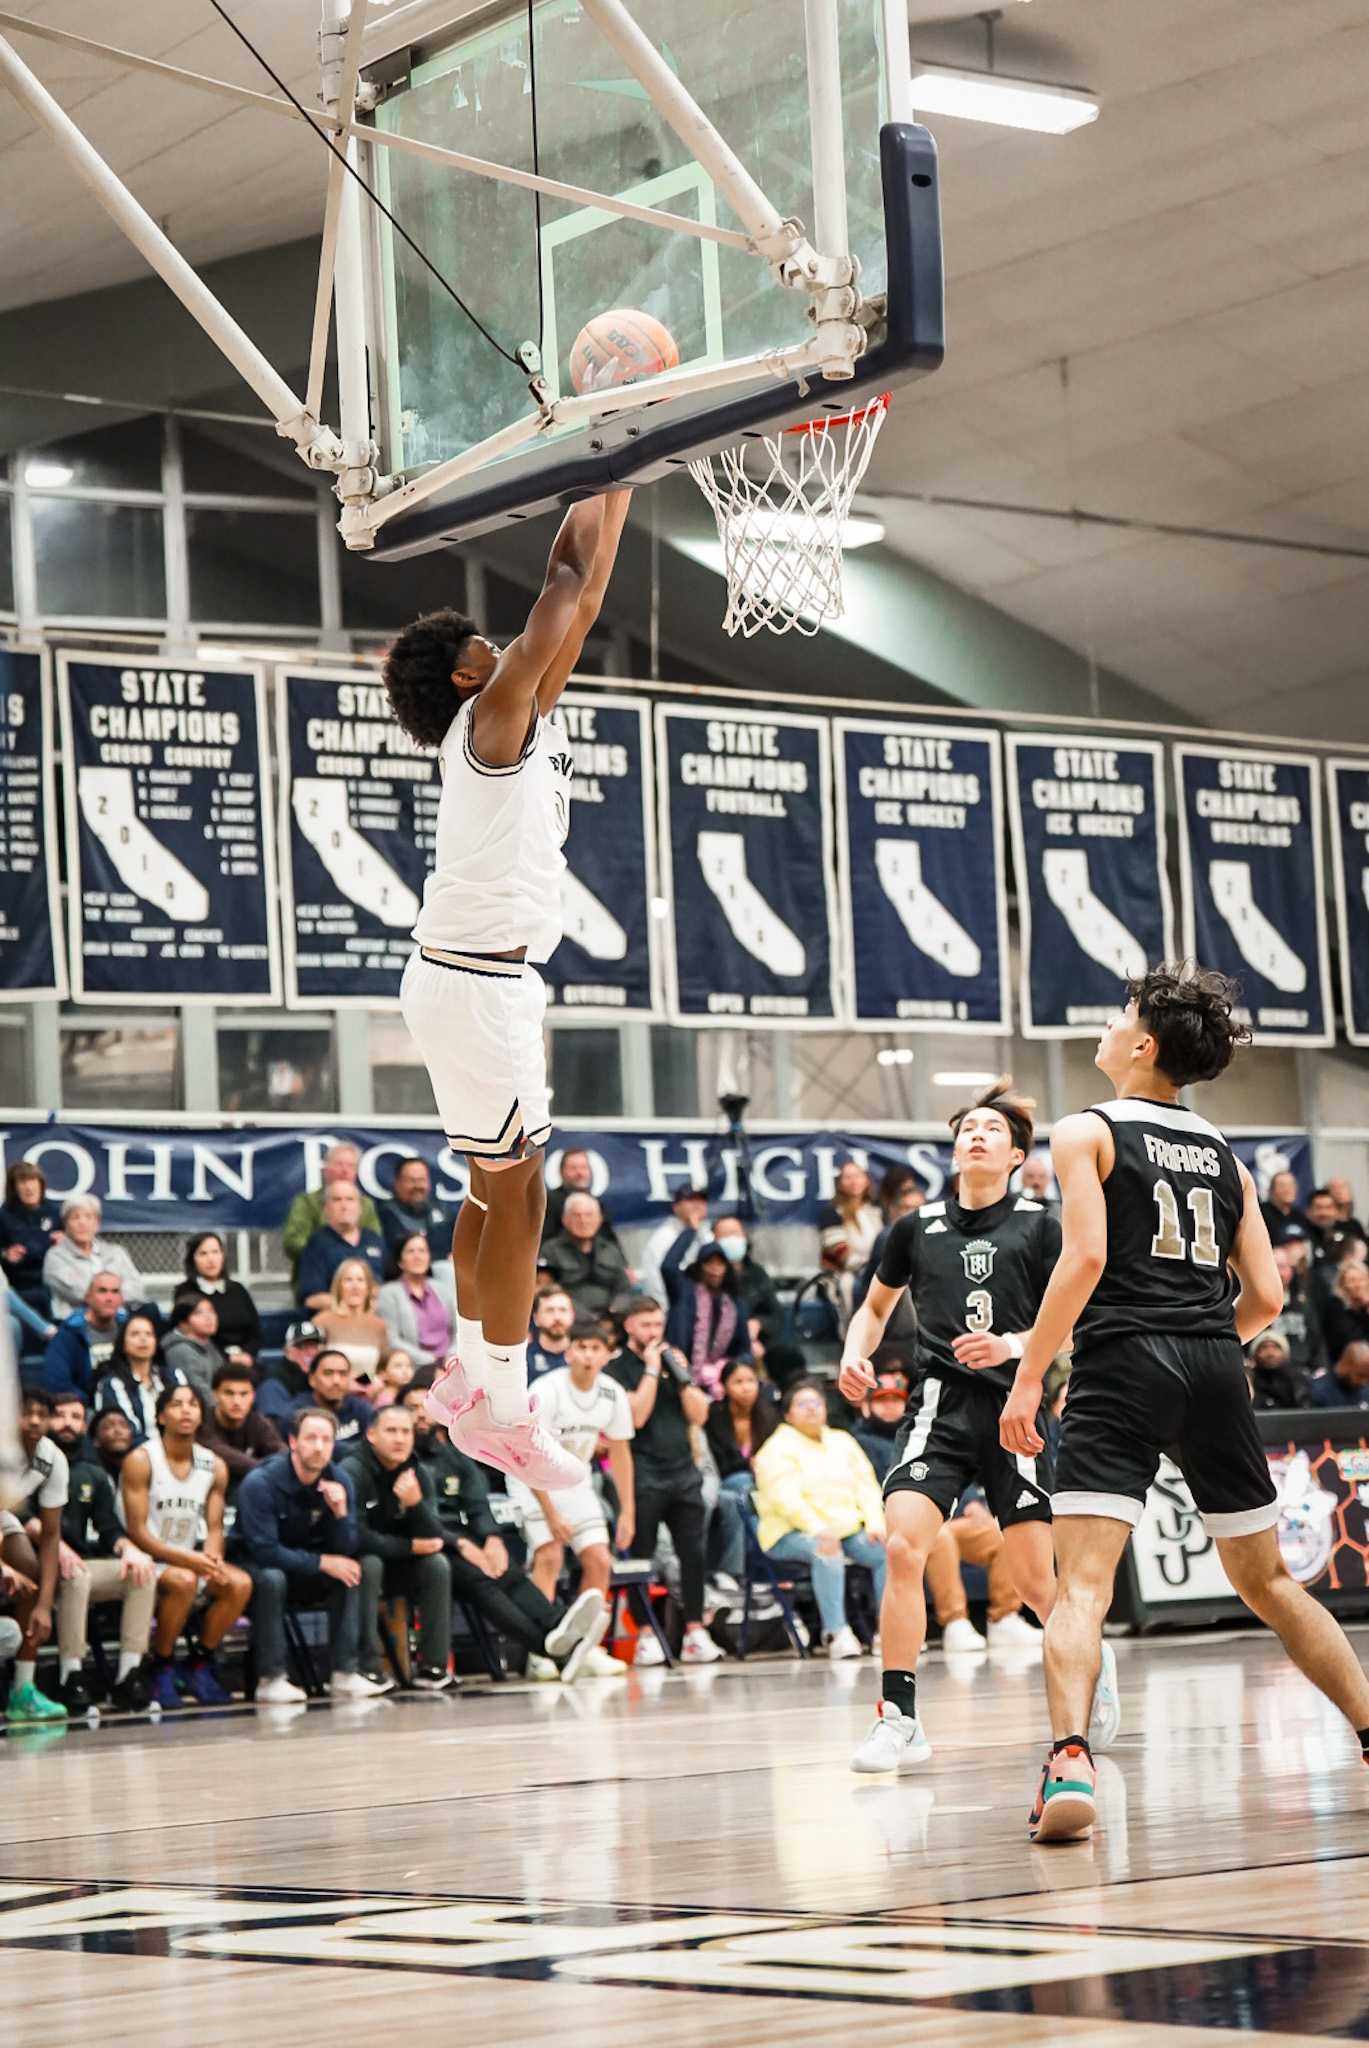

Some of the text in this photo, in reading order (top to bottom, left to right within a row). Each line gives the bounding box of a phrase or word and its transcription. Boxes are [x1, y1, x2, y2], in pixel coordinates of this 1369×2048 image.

[121, 670, 207, 707] STATE
[337, 684, 398, 720] STAT
[90, 704, 242, 746] CHAMPIONS
[551, 706, 598, 740] ATE
[706, 721, 781, 757] STATE
[883, 736, 954, 770] STATE
[1053, 748, 1121, 781] STATE
[681, 752, 808, 794] CHAMPIONS
[859, 766, 981, 804] CHAMPIONS
[1218, 760, 1278, 792] STATE
[1032, 778, 1145, 815] CHAMPIONS
[1196, 788, 1301, 825] CHAMPIONS
[295, 1133, 610, 1202] OSO
[1143, 1133, 1221, 1177] FRIARS
[1151, 1179, 1220, 1268] 11
[965, 1290, 994, 1333] 3
